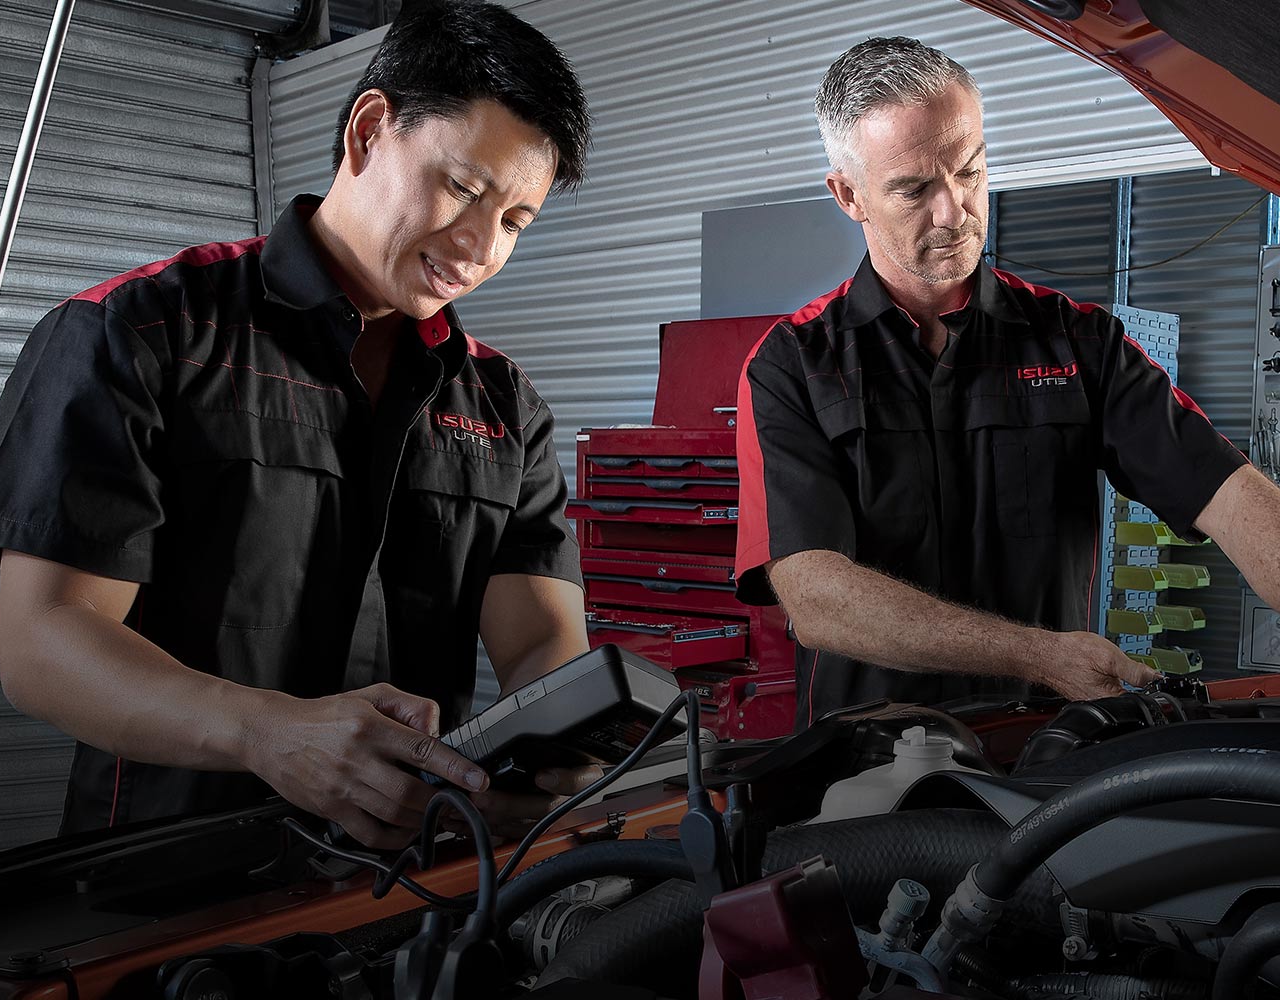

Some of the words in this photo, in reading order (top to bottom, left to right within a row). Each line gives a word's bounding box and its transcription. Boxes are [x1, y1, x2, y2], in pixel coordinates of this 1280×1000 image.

[1017, 363, 1079, 379] ISUZU
[1031, 377, 1067, 387] UTE
[435, 413, 505, 439] ISUZU
[453, 429, 492, 449] UTE
